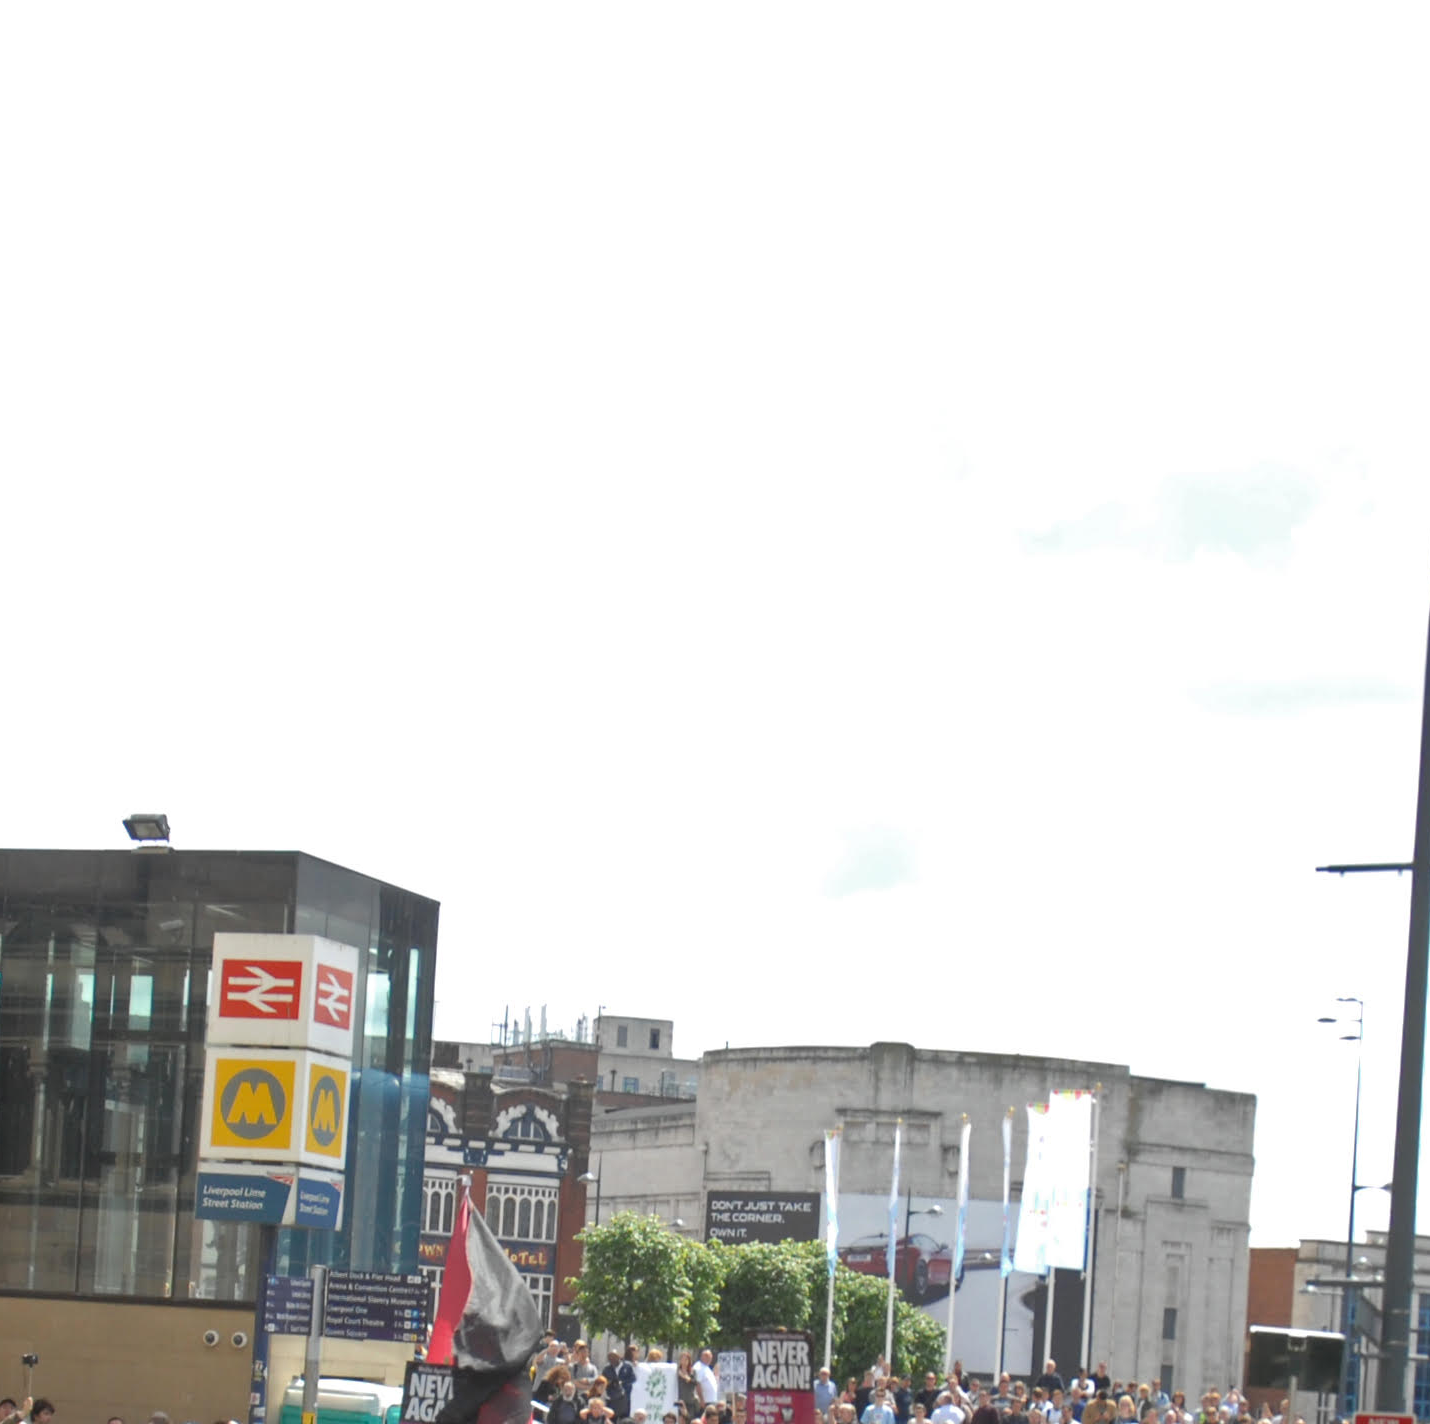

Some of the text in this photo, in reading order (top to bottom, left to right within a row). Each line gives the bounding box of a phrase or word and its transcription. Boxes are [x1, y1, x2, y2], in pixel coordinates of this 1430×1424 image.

[203, 1185, 267, 1198] Liverpool Lime
[202, 1198, 263, 1209] Street Station
[711, 1200, 812, 1212] DON'T JUST TAKE
[710, 1213, 785, 1225] THE CORNER.
[710, 1228, 734, 1238] OWN
[752, 1340, 809, 1365] NEVER
[752, 1364, 811, 1390] AGAIN!
[409, 1373, 454, 1400] NEV
